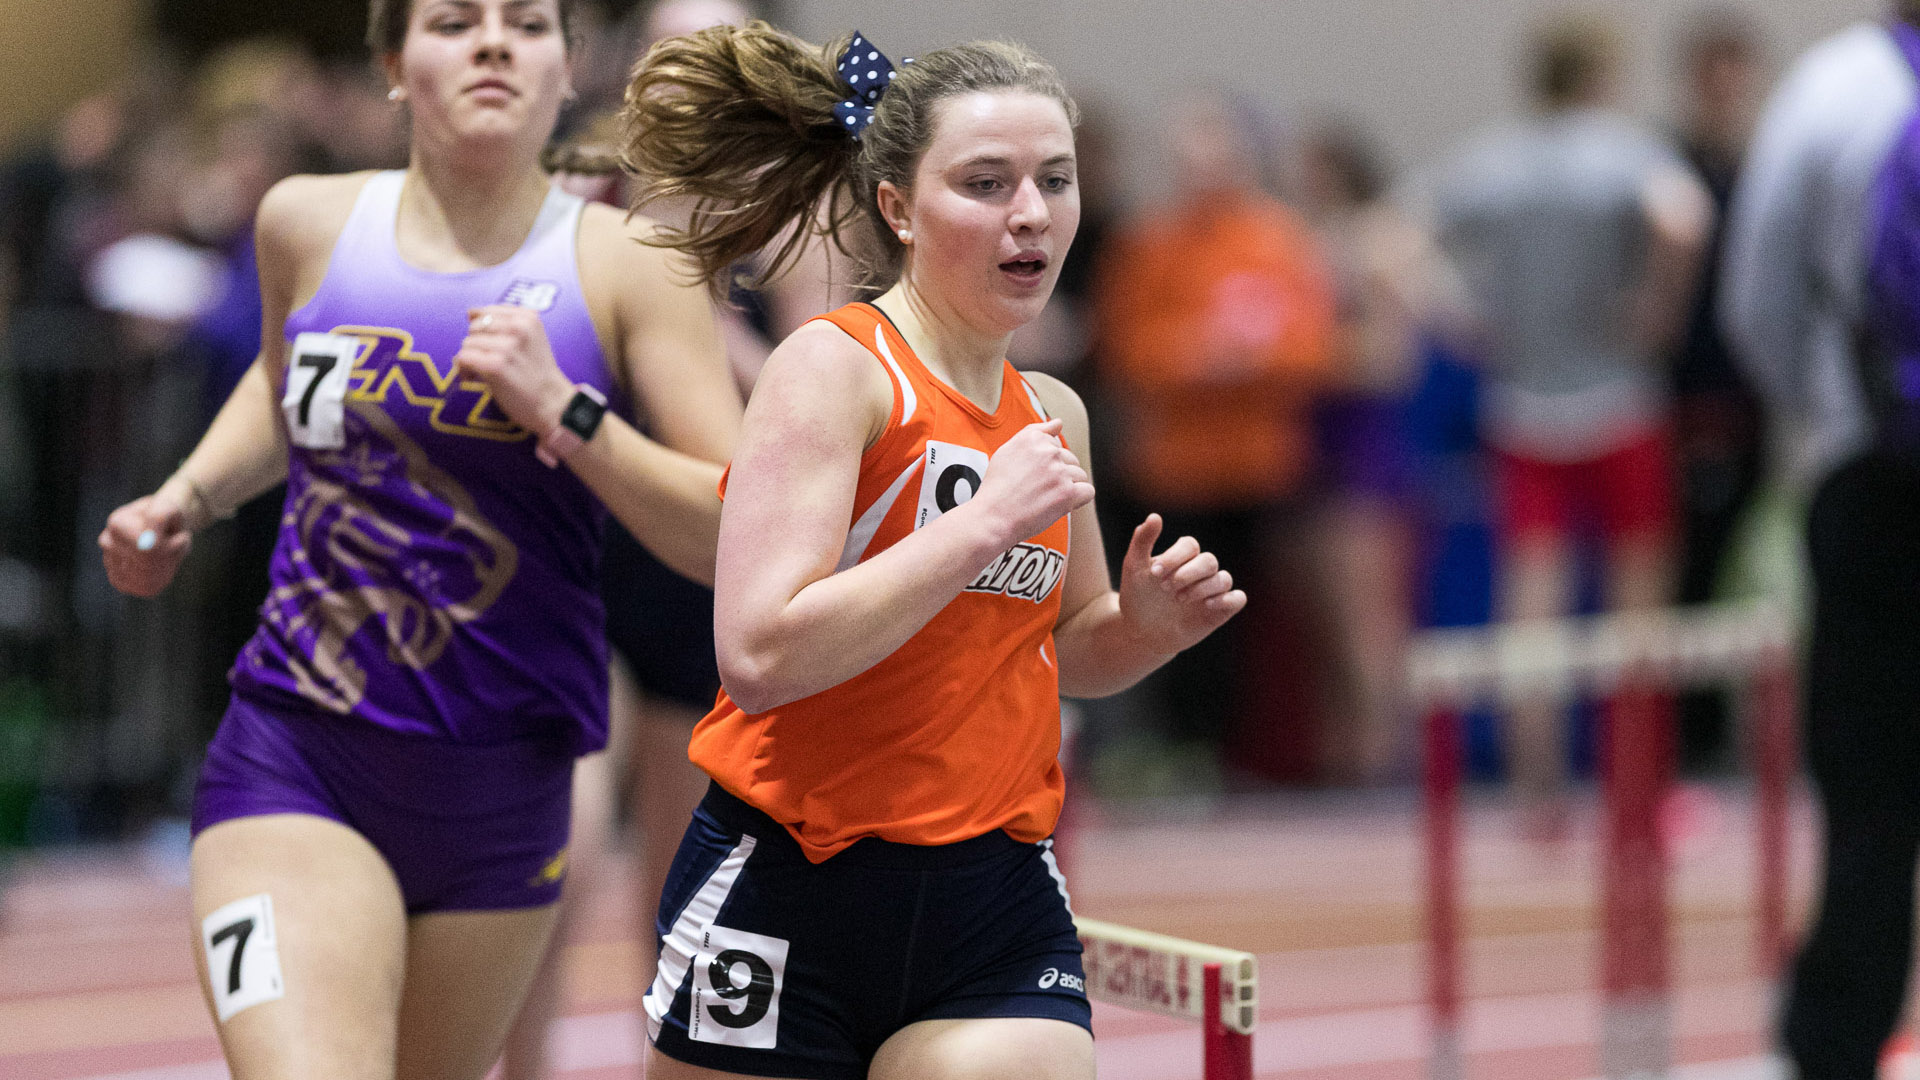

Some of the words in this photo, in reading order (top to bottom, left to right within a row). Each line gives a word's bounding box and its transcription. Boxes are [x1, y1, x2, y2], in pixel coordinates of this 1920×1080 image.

[298, 354, 337, 428] 7
[964, 542, 1066, 603] ATON
[212, 918, 255, 995] 7
[706, 949, 775, 1029] 9
